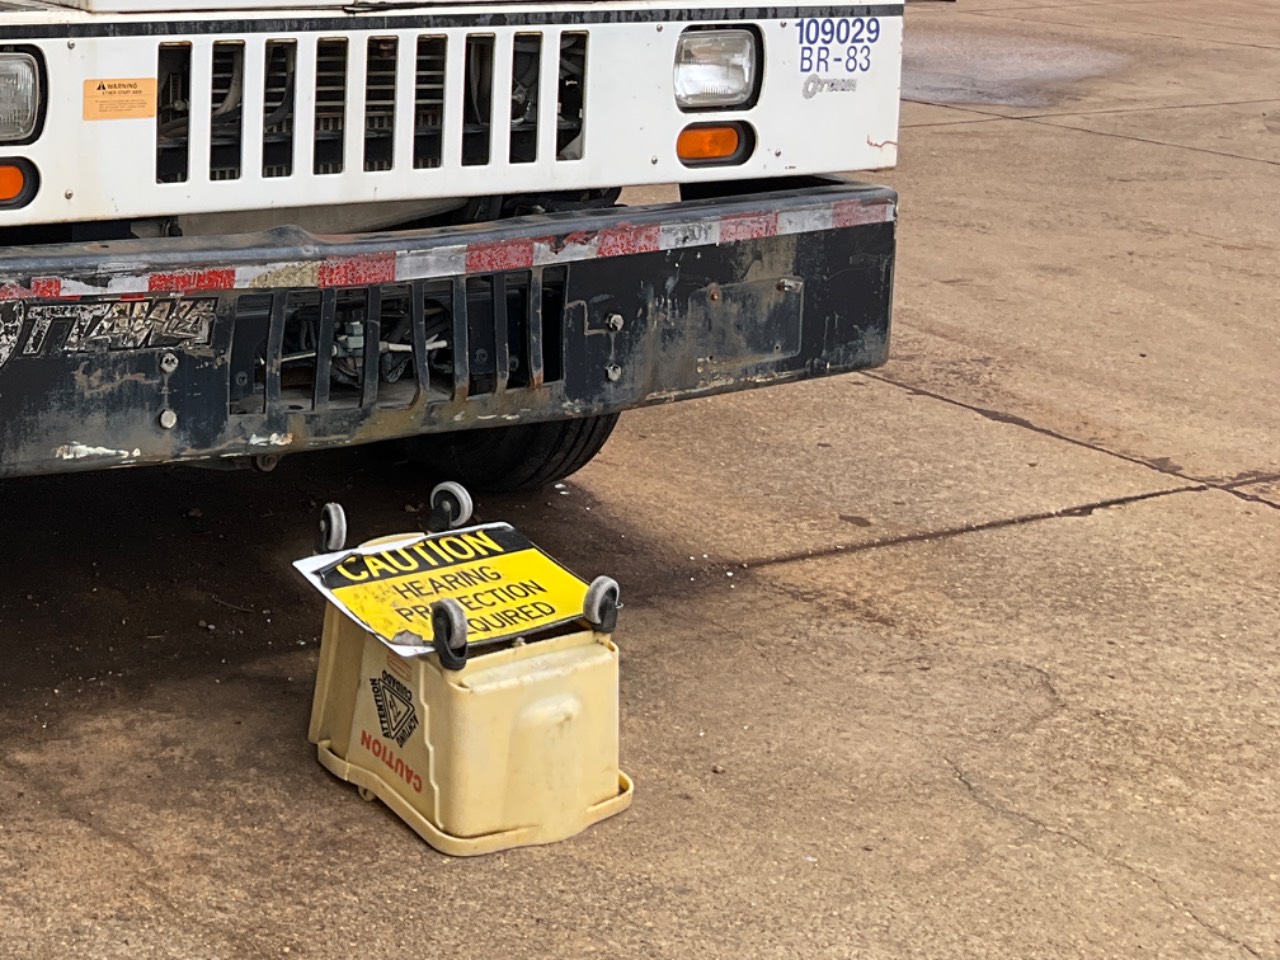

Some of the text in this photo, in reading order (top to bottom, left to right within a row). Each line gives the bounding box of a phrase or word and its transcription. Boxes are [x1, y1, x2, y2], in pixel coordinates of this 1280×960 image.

[794, 17, 881, 44] 109029
[800, 44, 871, 73] BR-83
[336, 529, 504, 582] CAUTION
[393, 565, 502, 600] HEARING
[394, 578, 547, 623] PRECTION
[370, 678, 391, 739] ATTENTION
[361, 730, 422, 794] CAUTION
